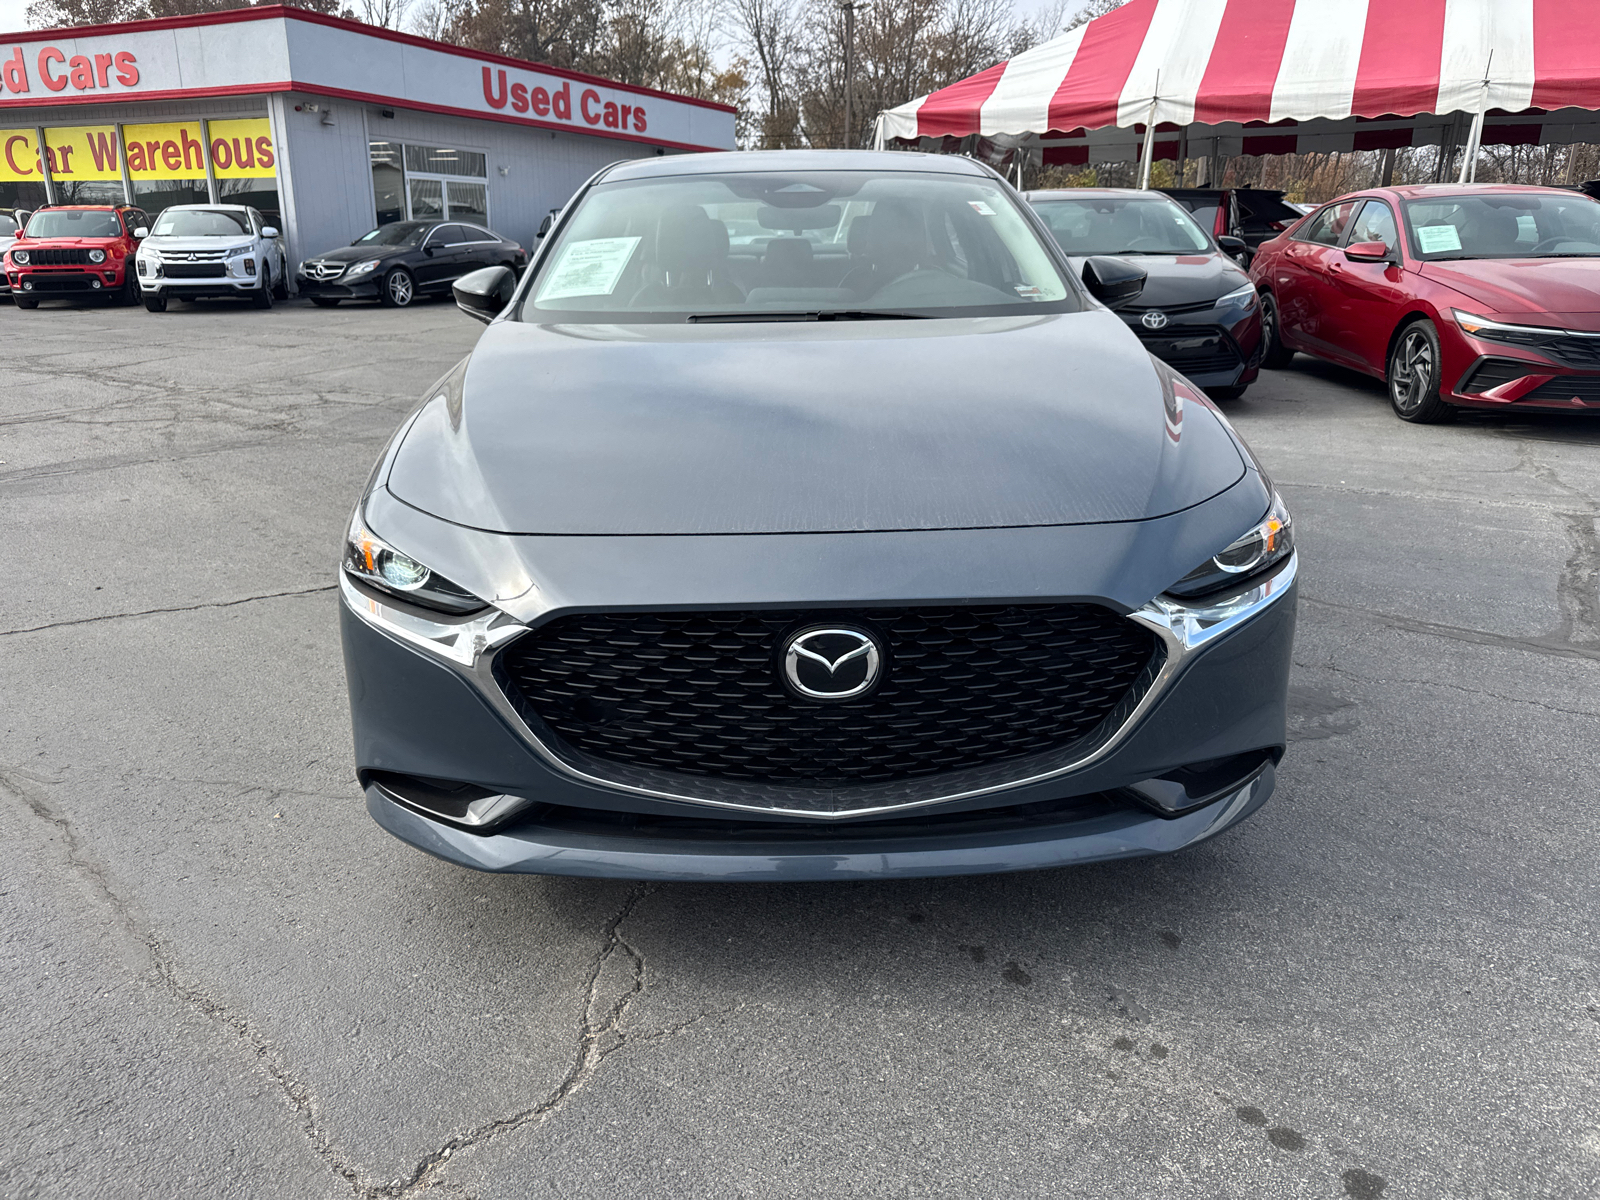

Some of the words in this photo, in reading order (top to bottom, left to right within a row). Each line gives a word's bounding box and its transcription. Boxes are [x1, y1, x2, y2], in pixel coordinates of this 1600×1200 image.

[0, 47, 30, 93] d
[38, 46, 140, 92] Cars
[482, 66, 572, 121] Used
[580, 88, 647, 133] Cars
[5, 135, 74, 176] Car
